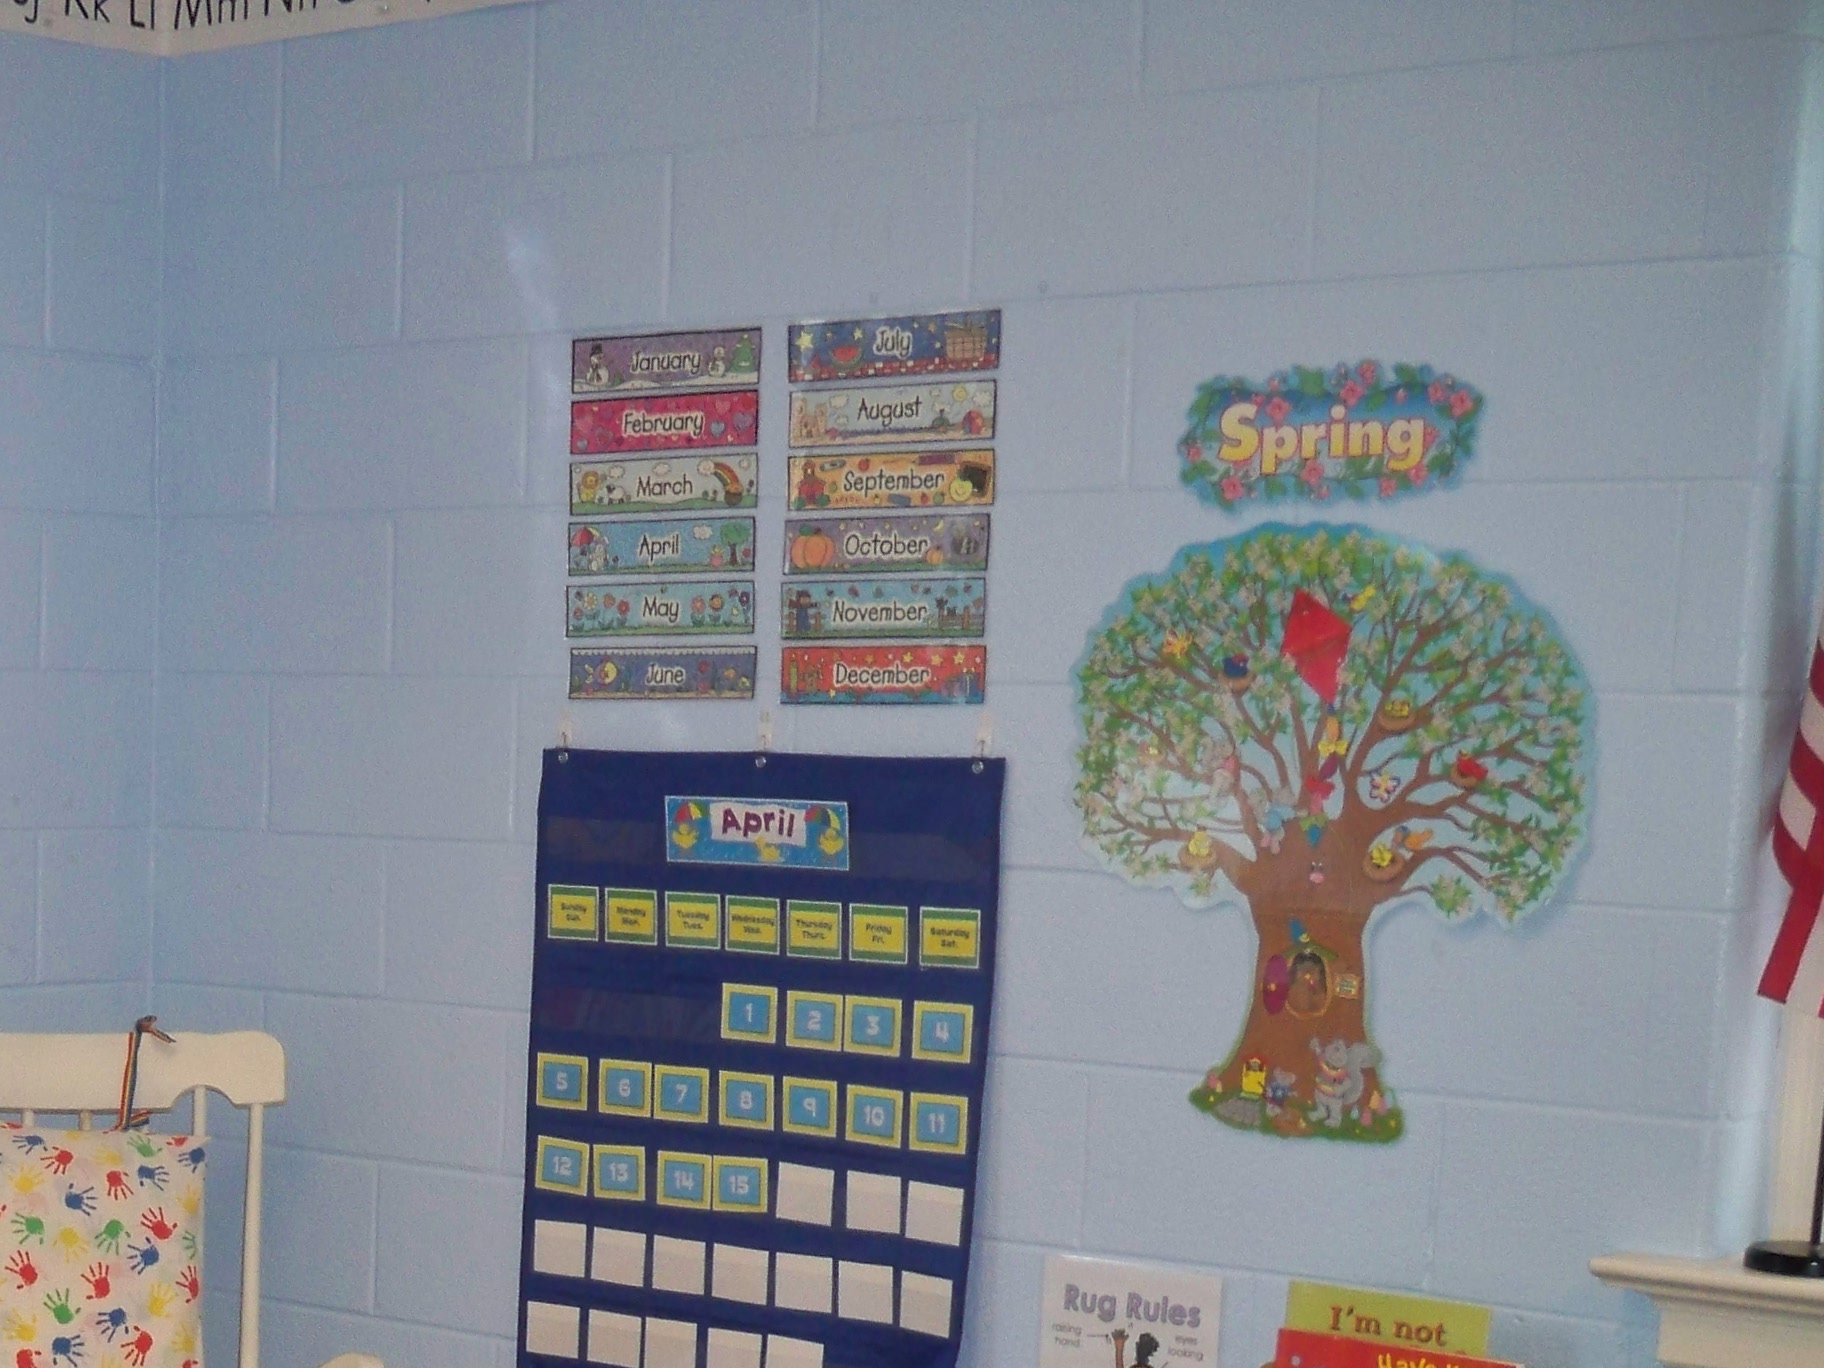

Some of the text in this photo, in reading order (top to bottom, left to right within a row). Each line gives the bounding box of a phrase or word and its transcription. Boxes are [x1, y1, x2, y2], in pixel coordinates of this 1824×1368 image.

[631, 328, 911, 375] January July
[623, 396, 923, 437] February August
[1217, 402, 1425, 475] Spring
[636, 469, 945, 498] March September
[639, 532, 930, 562] April October
[643, 596, 928, 623] May November
[646, 661, 930, 686] June December
[720, 808, 796, 838] April
[796, 919, 832, 931] Thursday
[930, 927, 970, 938] Saturday
[745, 1002, 950, 1044] 1 2 3 4
[556, 1071, 946, 1134] 5 6 7 8 9 10 11
[553, 1155, 750, 1195] 12 13 14 15
[1064, 1284, 1201, 1328] Rug Rules
[1330, 1305, 1447, 1347] I'm not
